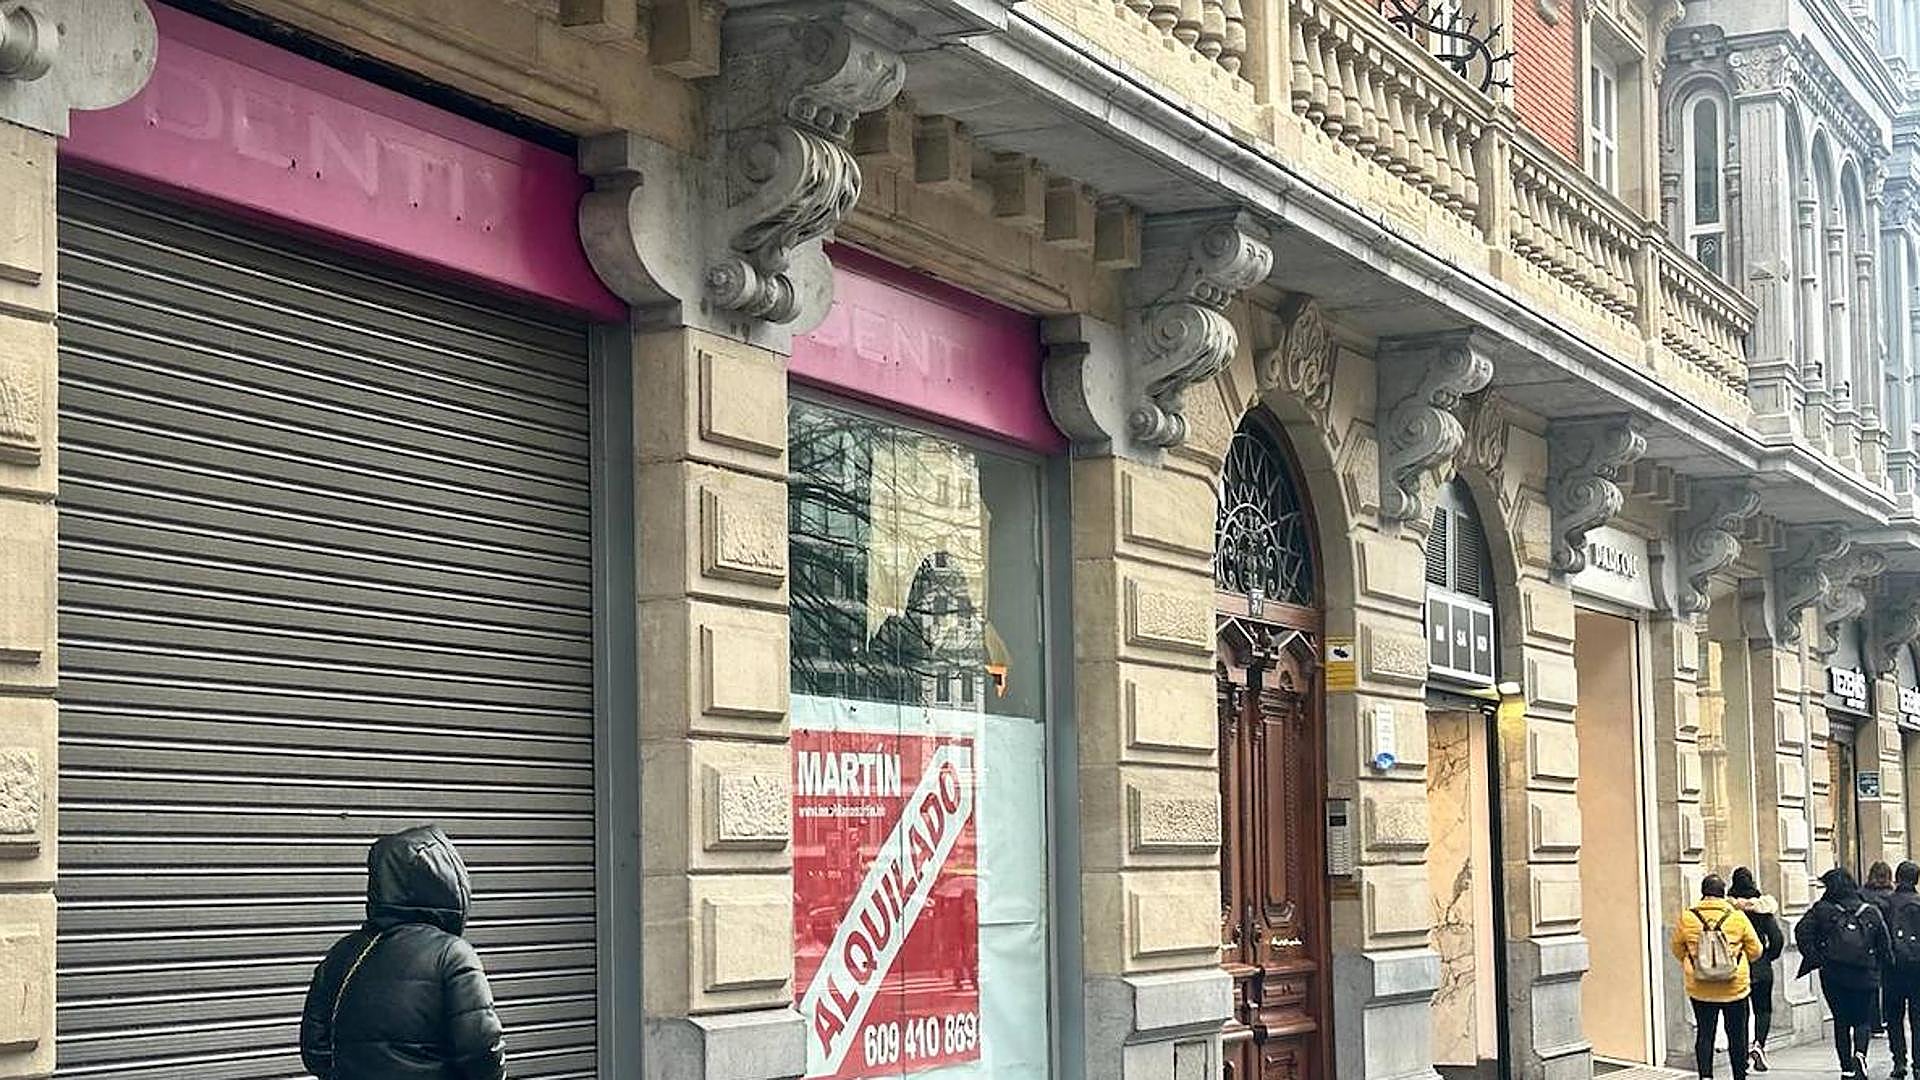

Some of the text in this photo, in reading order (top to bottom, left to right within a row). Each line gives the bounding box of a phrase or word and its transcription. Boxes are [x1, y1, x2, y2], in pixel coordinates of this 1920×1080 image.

[798, 742, 902, 797] MARTÍN
[814, 761, 961, 1060] ALQUILADO
[864, 1011, 978, 1067] 609 410 869
